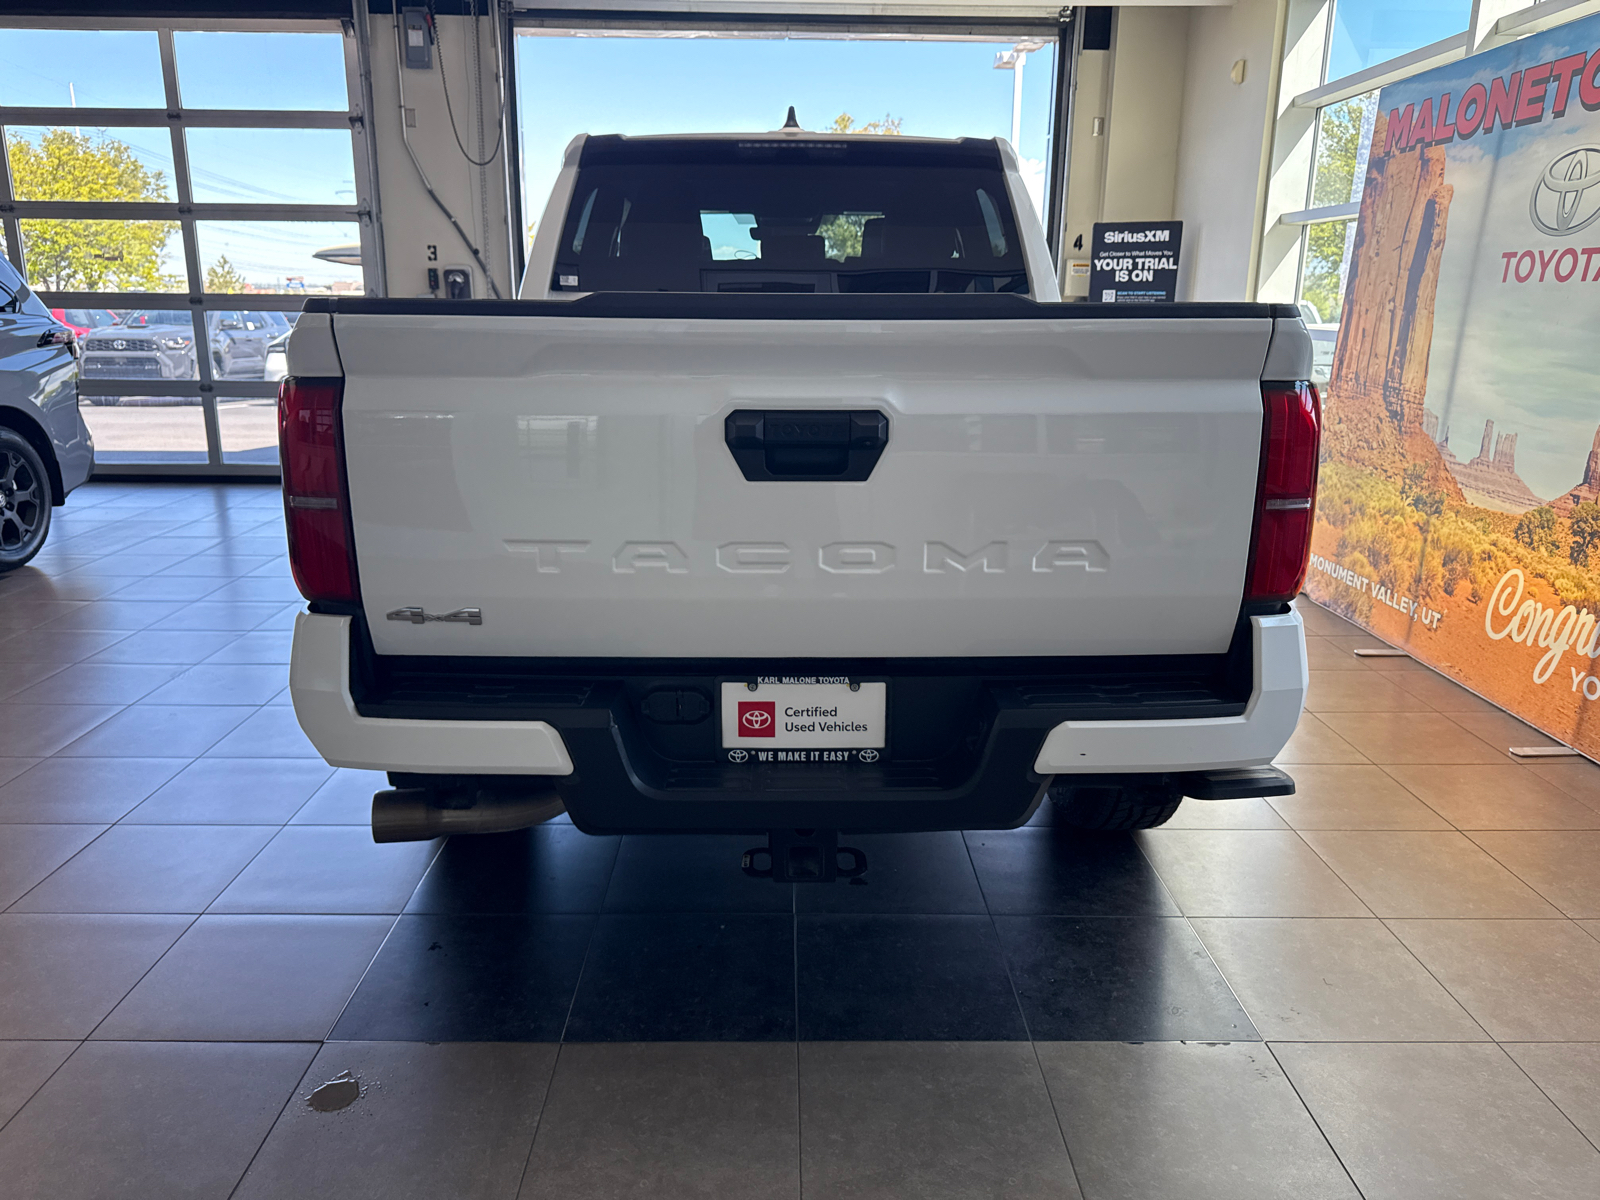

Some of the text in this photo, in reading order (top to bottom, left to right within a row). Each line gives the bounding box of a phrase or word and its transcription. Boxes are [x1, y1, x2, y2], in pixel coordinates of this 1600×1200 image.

[1073, 234, 1083, 251] 4
[1104, 229, 1170, 243] SiriusXM
[427, 244, 437, 261] 3
[1094, 258, 1133, 271] YOUR
[1135, 257, 1178, 270] TRIAL
[1115, 269, 1154, 282] IS ON
[502, 539, 1110, 574] TACOMA
[1309, 552, 1442, 629] MONUMENT VALLEY, UT
[757, 676, 850, 684] KARL MALONE TOYOTA
[784, 706, 838, 717] Certified
[784, 721, 868, 732] Used Vehicles
[758, 751, 849, 761] WE MAKE IT EASY
